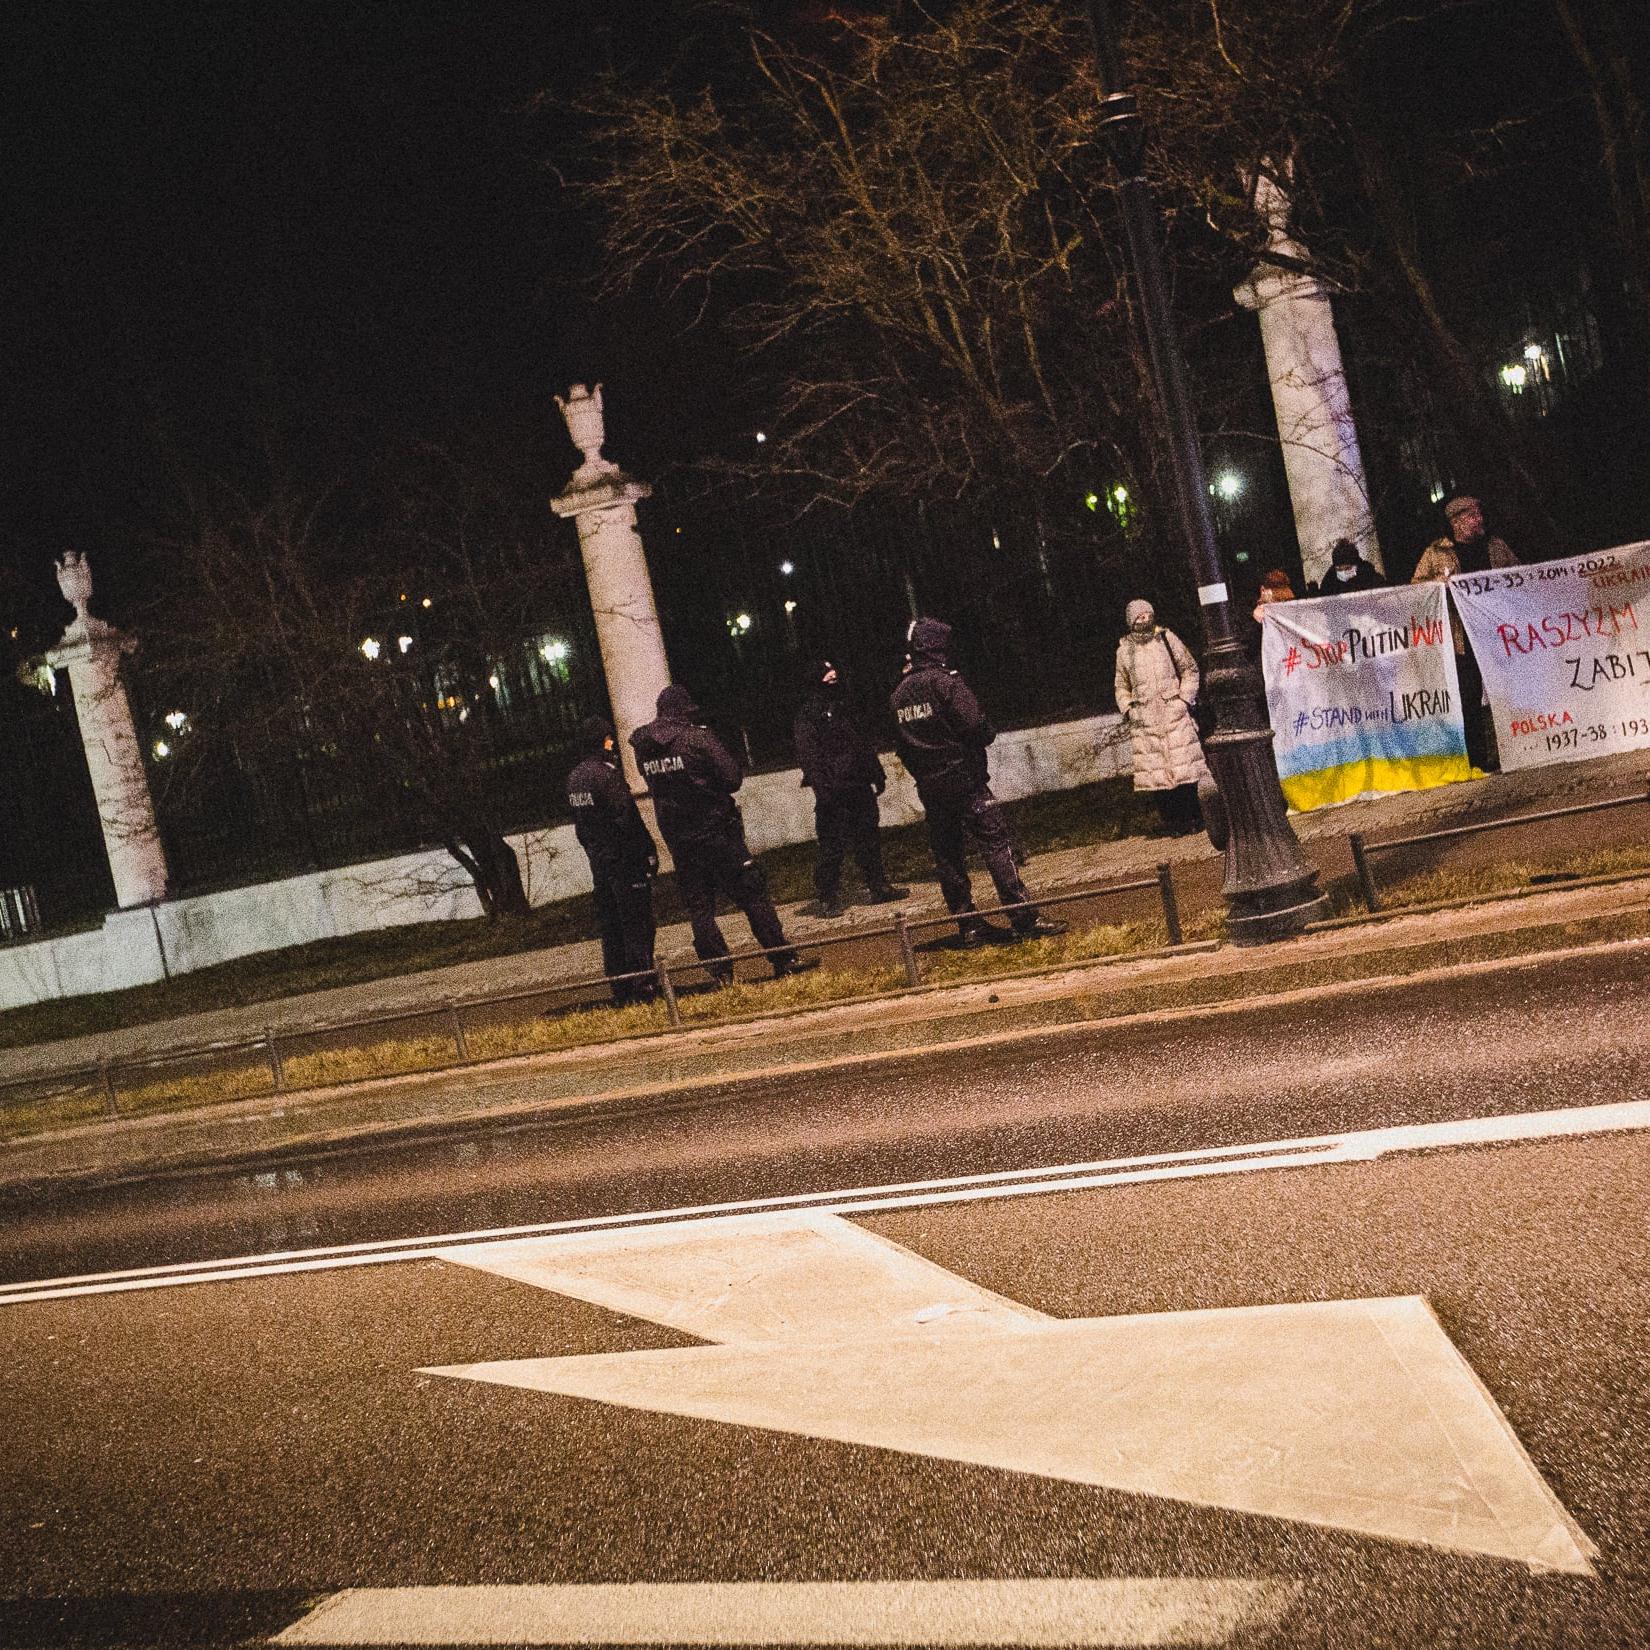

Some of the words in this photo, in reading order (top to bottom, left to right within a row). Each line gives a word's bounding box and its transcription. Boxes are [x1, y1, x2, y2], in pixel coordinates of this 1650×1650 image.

[1577, 556, 1615, 579] 2022
[1496, 602, 1638, 657] RASZYZM
[1510, 711, 1574, 737] POLSKA
[1546, 724, 1607, 752] 1937-38
[643, 756, 684, 776] POLICJA
